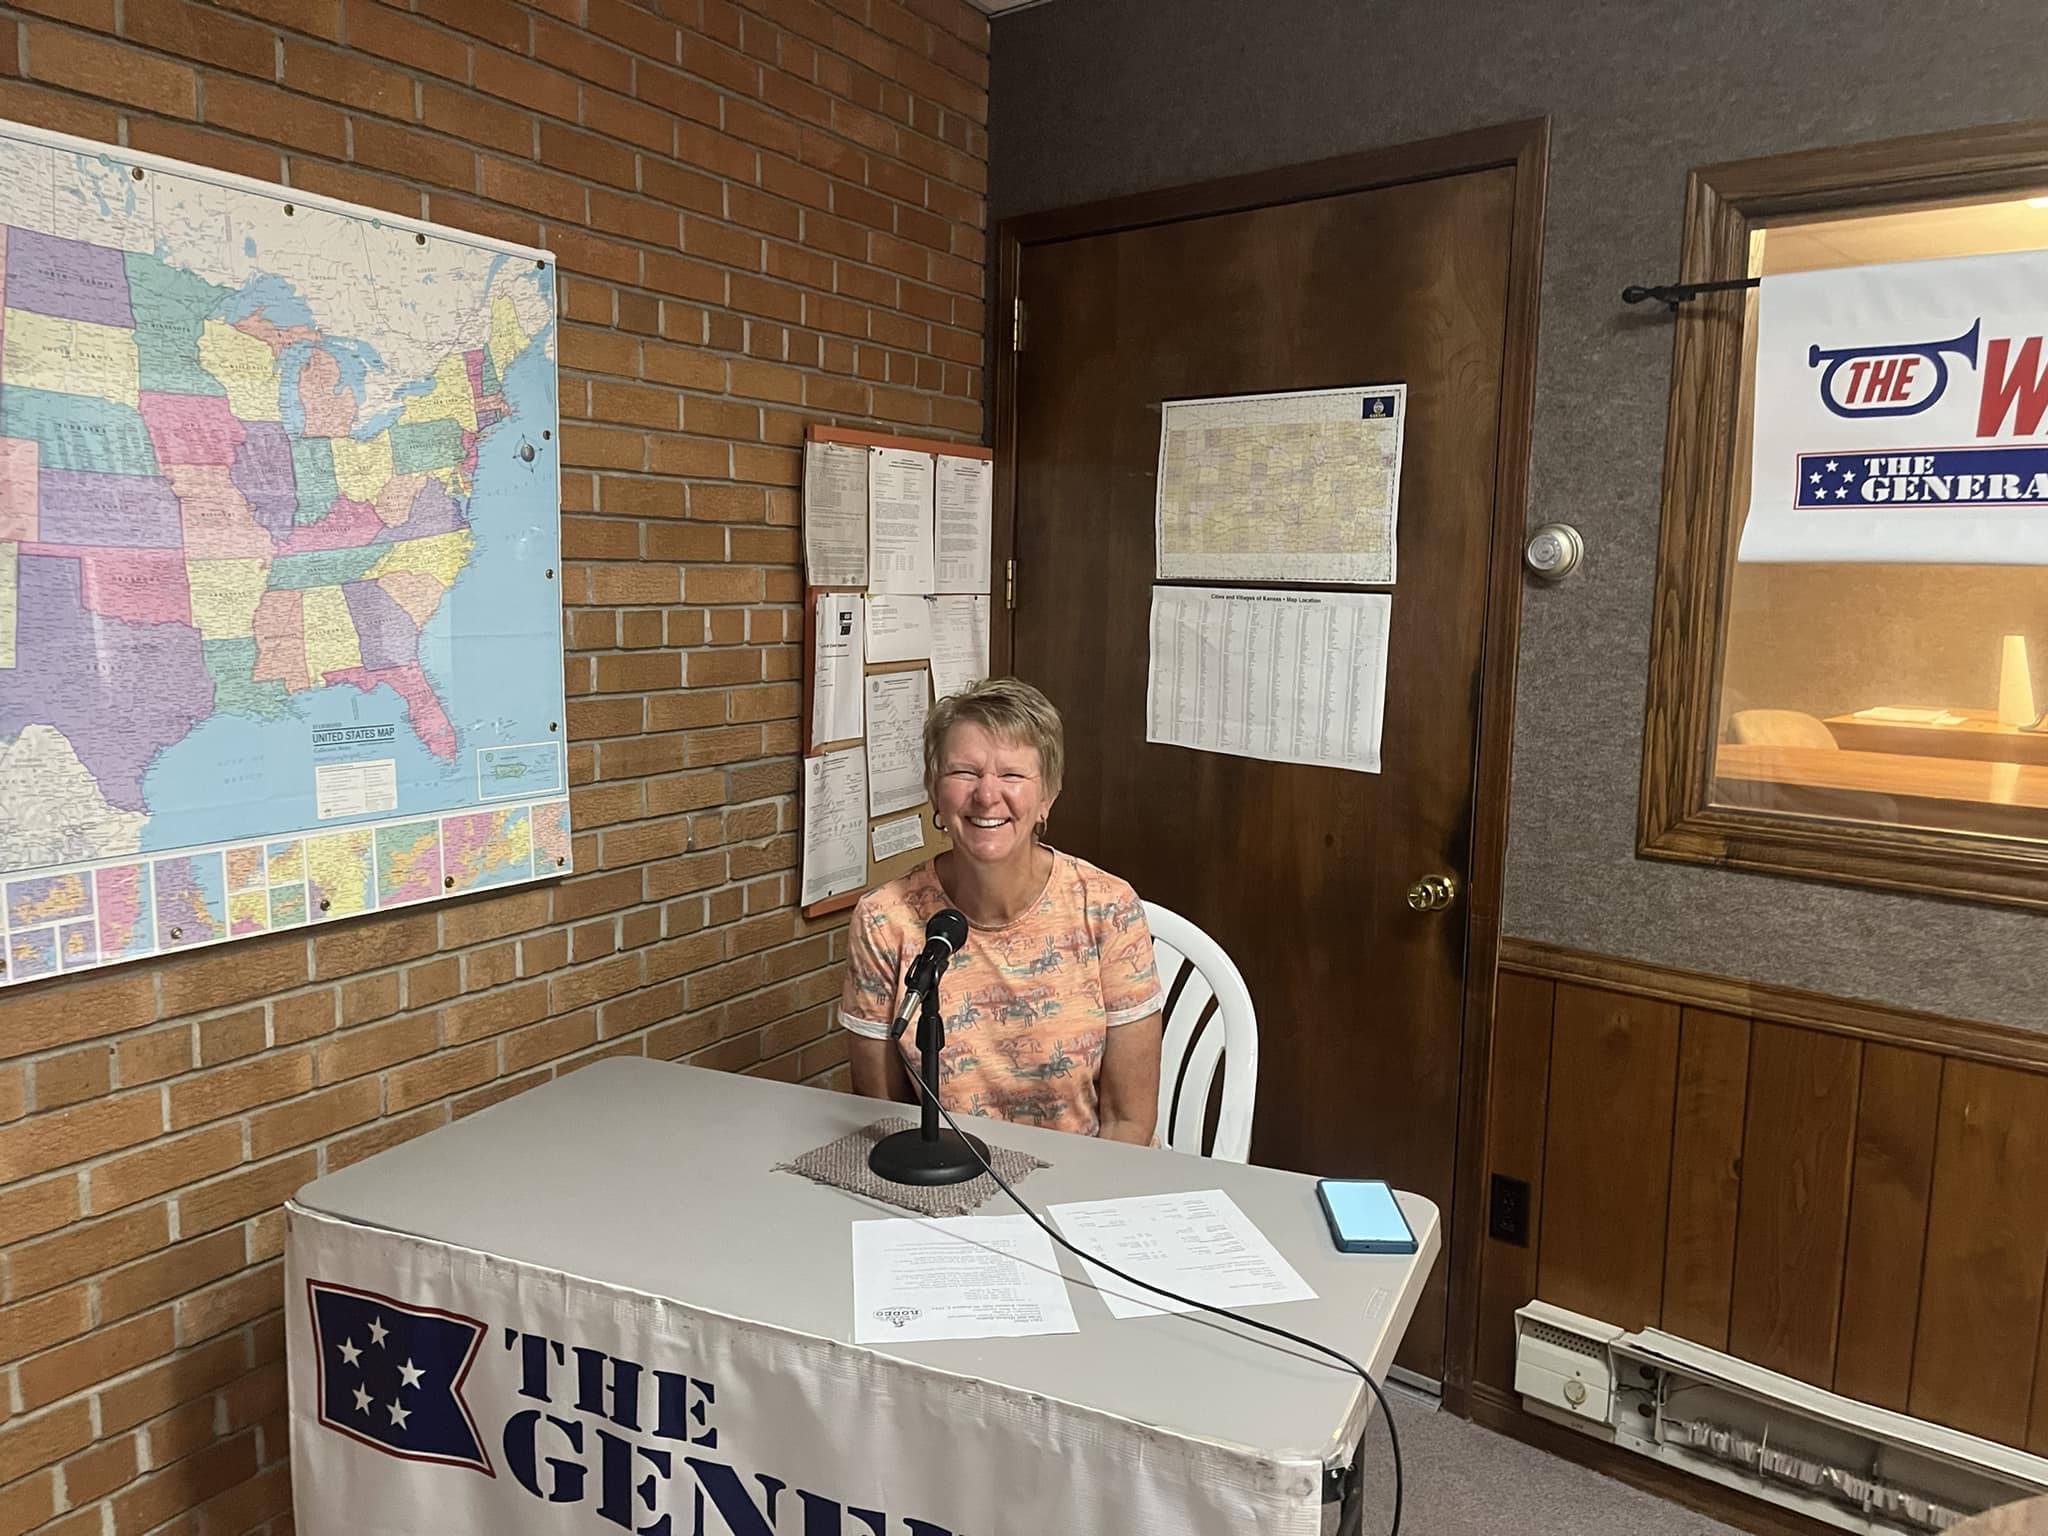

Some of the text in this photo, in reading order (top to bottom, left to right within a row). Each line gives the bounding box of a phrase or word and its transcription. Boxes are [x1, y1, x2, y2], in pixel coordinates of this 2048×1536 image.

[1845, 336, 2048, 438] THE W
[1864, 456, 1935, 476] THE
[1861, 474, 2048, 501] GENERA
[1236, 594, 1255, 603] Villages
[1263, 595, 1282, 603] Kansas
[1286, 596, 1298, 604] Map
[312, 727, 395, 743] UNITED STATES MAP
[504, 1327, 718, 1449] THE
[503, 1409, 966, 1536] GEN
